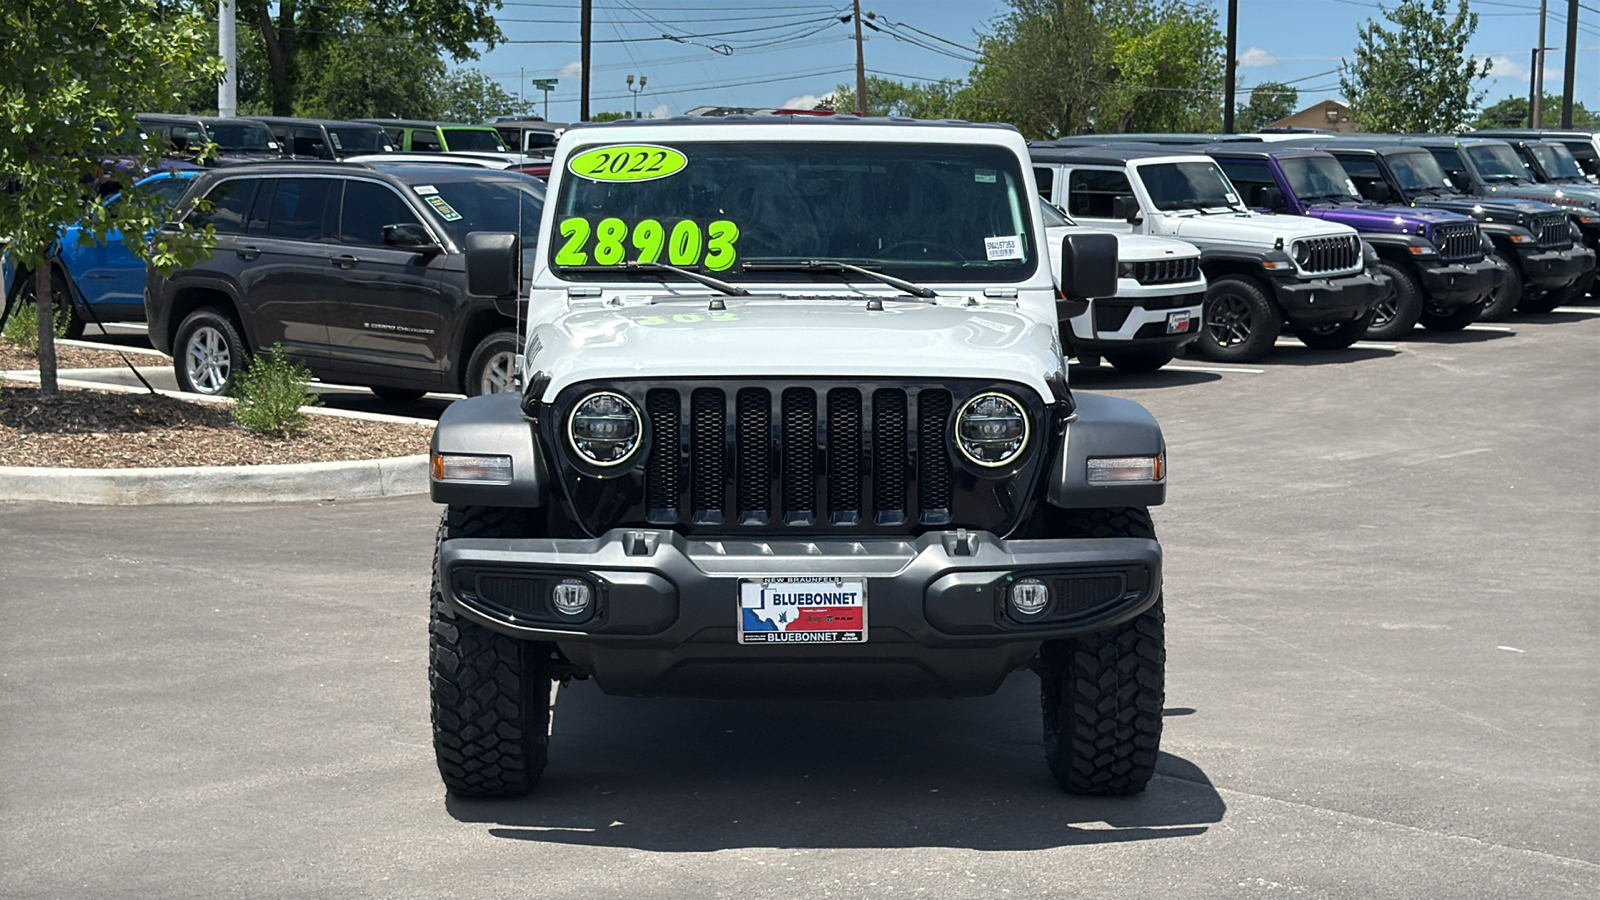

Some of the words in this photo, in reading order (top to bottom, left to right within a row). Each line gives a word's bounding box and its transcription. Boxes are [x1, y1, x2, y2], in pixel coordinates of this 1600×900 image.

[589, 151, 667, 174] 2022
[555, 217, 740, 272] 28903
[773, 593, 857, 606] BLUEBONNET
[767, 632, 838, 642] BLUEBONNET
